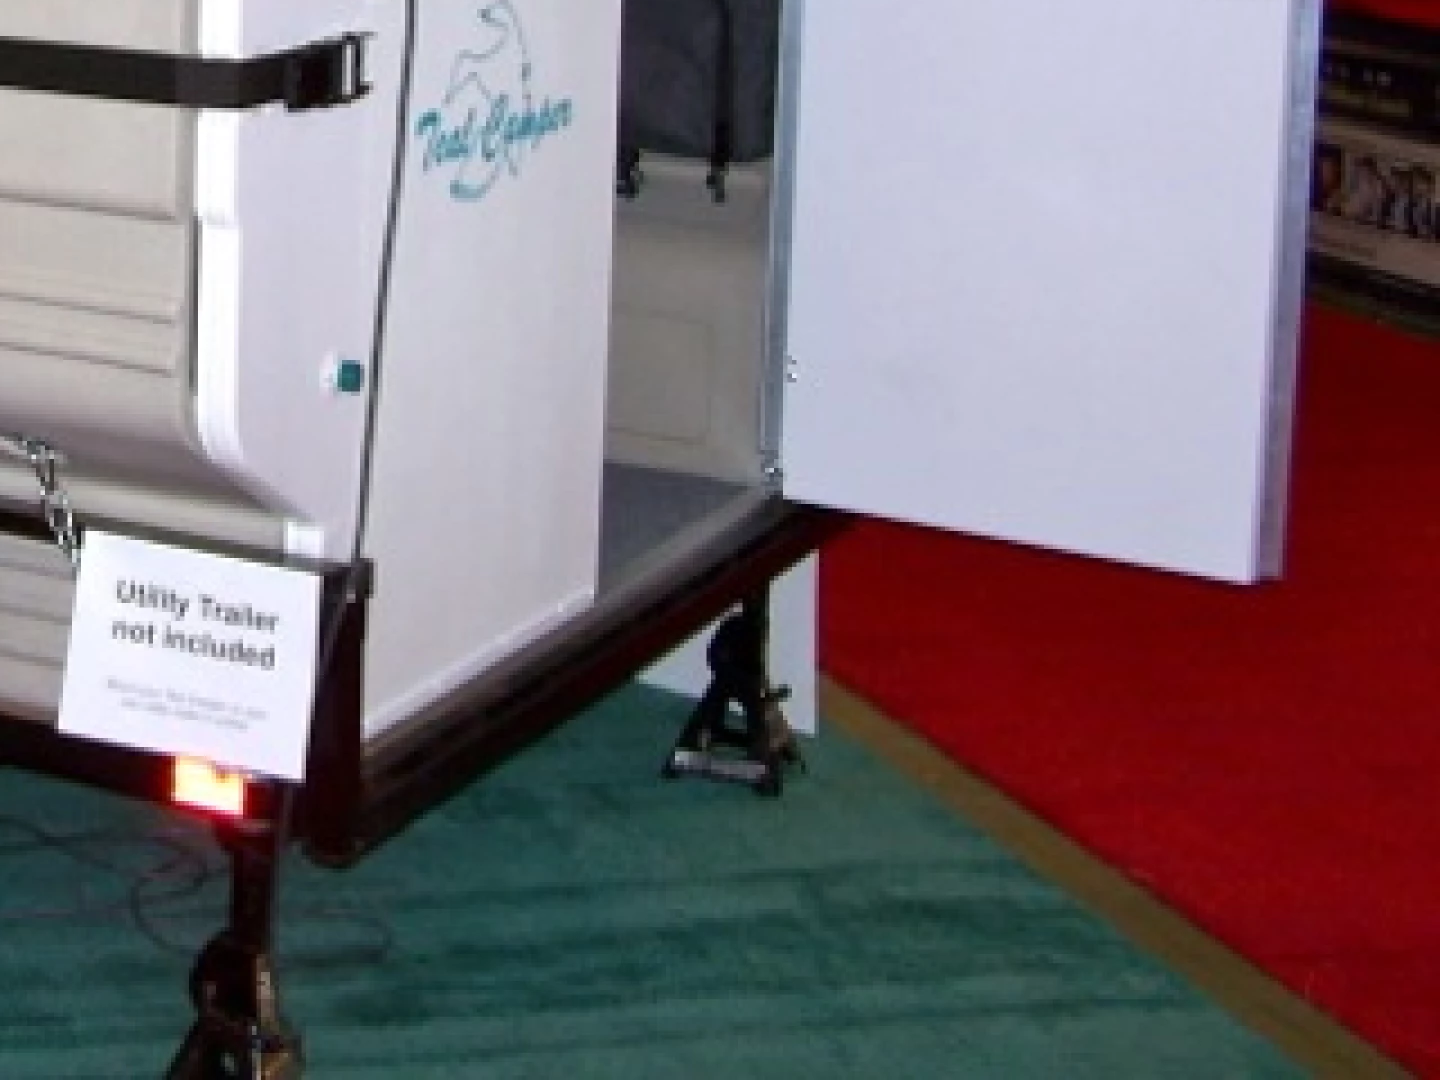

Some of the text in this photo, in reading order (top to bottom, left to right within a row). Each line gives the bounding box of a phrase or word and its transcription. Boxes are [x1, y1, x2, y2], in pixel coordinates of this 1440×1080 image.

[116, 580, 279, 633] Utility Trailer
[112, 620, 275, 671] not included
